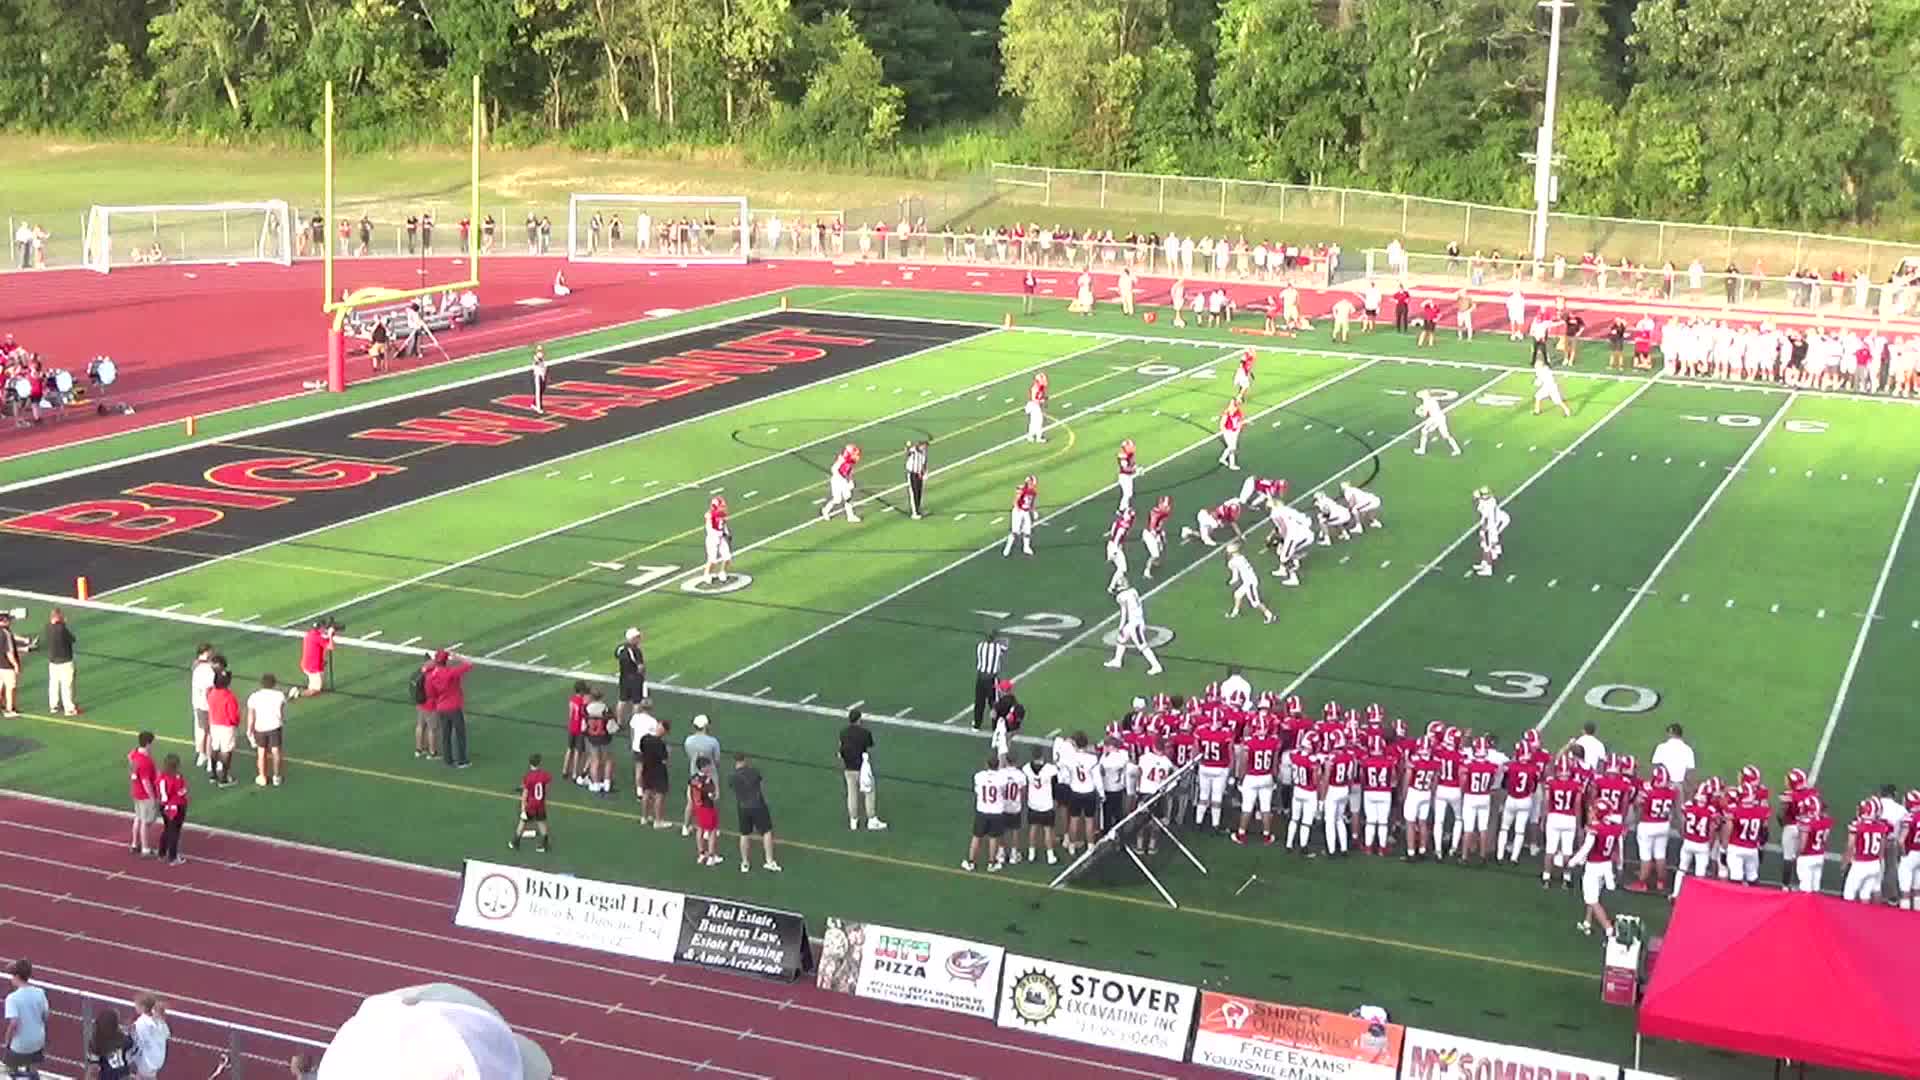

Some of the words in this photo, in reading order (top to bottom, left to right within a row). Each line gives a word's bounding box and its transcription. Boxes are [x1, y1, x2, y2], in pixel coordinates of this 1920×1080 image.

[0, 457, 409, 544] BIG
[349, 327, 876, 447] WALNUT
[624, 564, 754, 594] 10
[998, 612, 1176, 648] 20
[1473, 670, 1660, 712] 30
[1201, 740, 1221, 761] 75
[1254, 750, 1273, 771] 66
[1367, 766, 1388, 788] 64
[1471, 772, 1491, 793] 60
[1516, 772, 1528, 792] 3
[534, 782, 544, 801] 0
[982, 784, 998, 804] 19
[1553, 789, 1573, 810] 51
[1685, 812, 1709, 838] 24
[1739, 818, 1761, 841] 79
[1602, 834, 1615, 857] 9
[1862, 831, 1882, 855] 16
[525, 876, 570, 901] BKD
[576, 885, 627, 912] Legal
[632, 896, 678, 921] LLC
[706, 903, 737, 921] Real
[736, 909, 778, 930] Estate,
[697, 918, 751, 940] Business
[752, 927, 783, 946] Law,
[690, 932, 730, 951] Estate
[728, 939, 785, 964] Planning
[695, 950, 727, 965] Auto
[726, 956, 784, 975] Accidents
[874, 959, 927, 979] PIZZA
[1070, 974, 1181, 1015] STOVER
[1066, 998, 1149, 1025] EXCAVATING
[1153, 1015, 1177, 1033] INC
[1240, 1041, 1285, 1062] FREE
